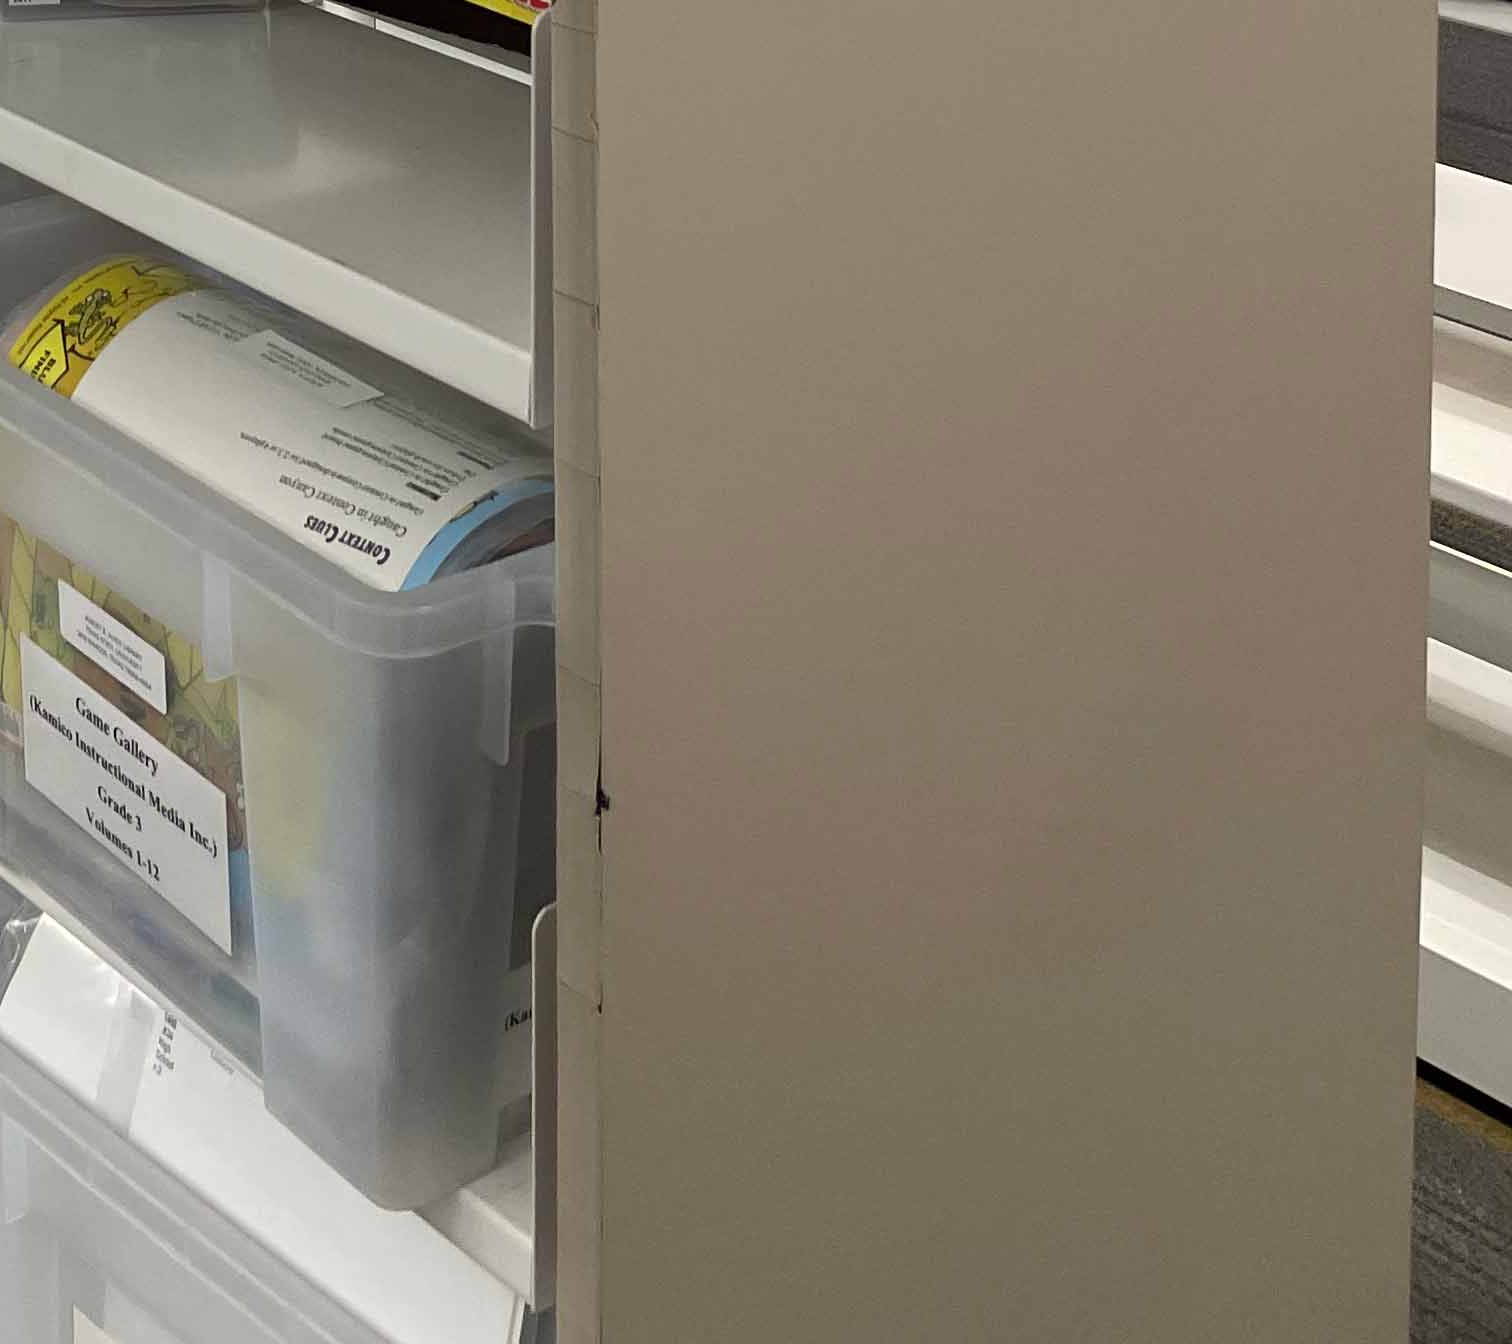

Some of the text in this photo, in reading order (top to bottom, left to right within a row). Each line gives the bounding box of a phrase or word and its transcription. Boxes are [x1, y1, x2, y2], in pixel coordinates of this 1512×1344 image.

[303, 514, 393, 566] CLUES CONTEXT
[74, 696, 160, 779] Game Gallery
[28, 694, 219, 861] (Kamico Instructional Media Inc.)
[97, 785, 144, 835] Grade 3
[84, 806, 162, 883] Volumes 1-12
